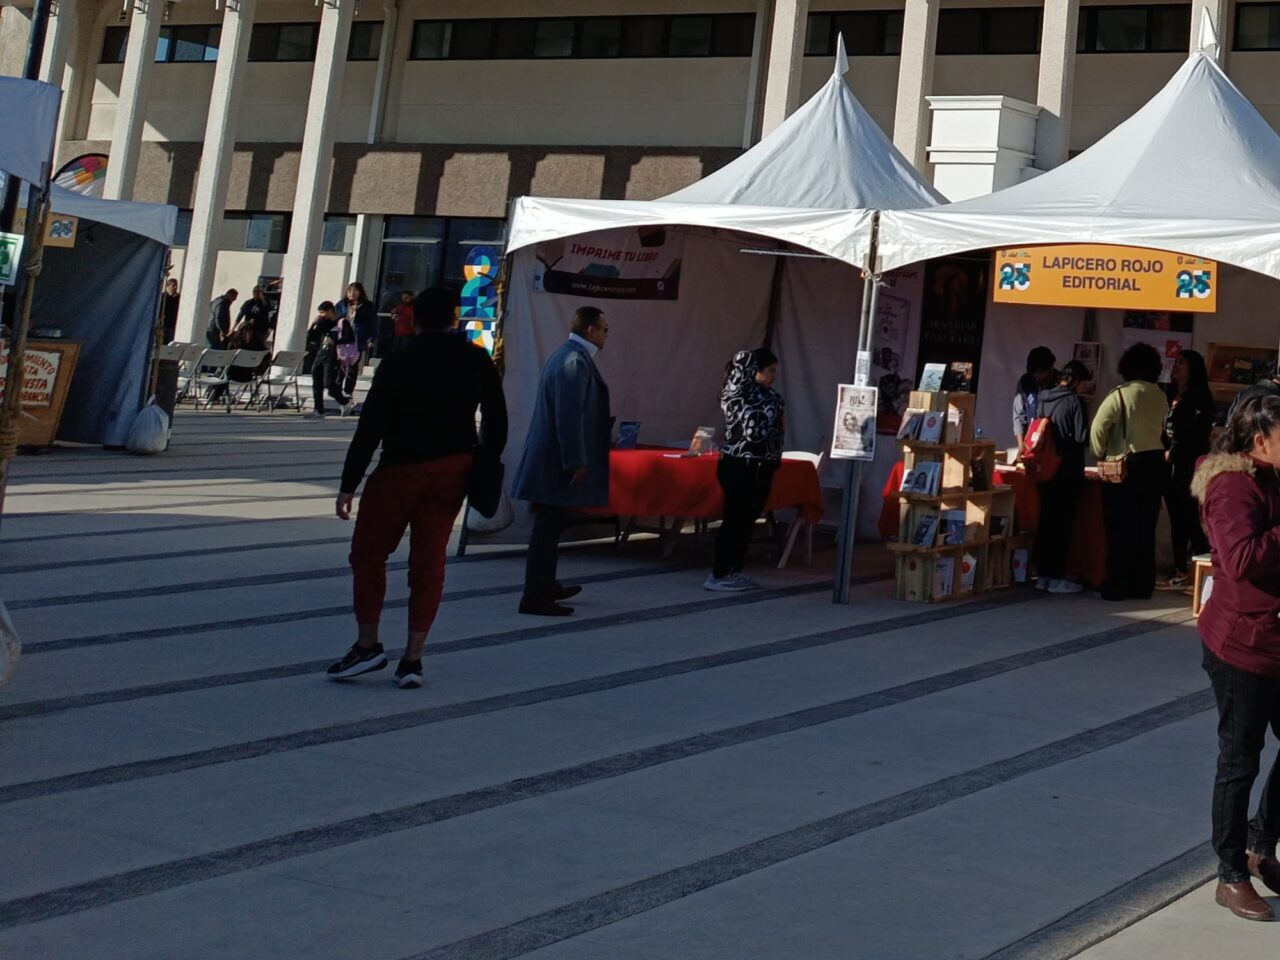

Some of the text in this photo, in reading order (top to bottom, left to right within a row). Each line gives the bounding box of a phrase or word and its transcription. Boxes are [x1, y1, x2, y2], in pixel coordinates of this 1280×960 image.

[570, 243, 622, 261] IMPRIME
[624, 251, 637, 262] TU
[1042, 255, 1164, 273] LAPICERO ROJO
[1062, 275, 1141, 291] EDITORIAL
